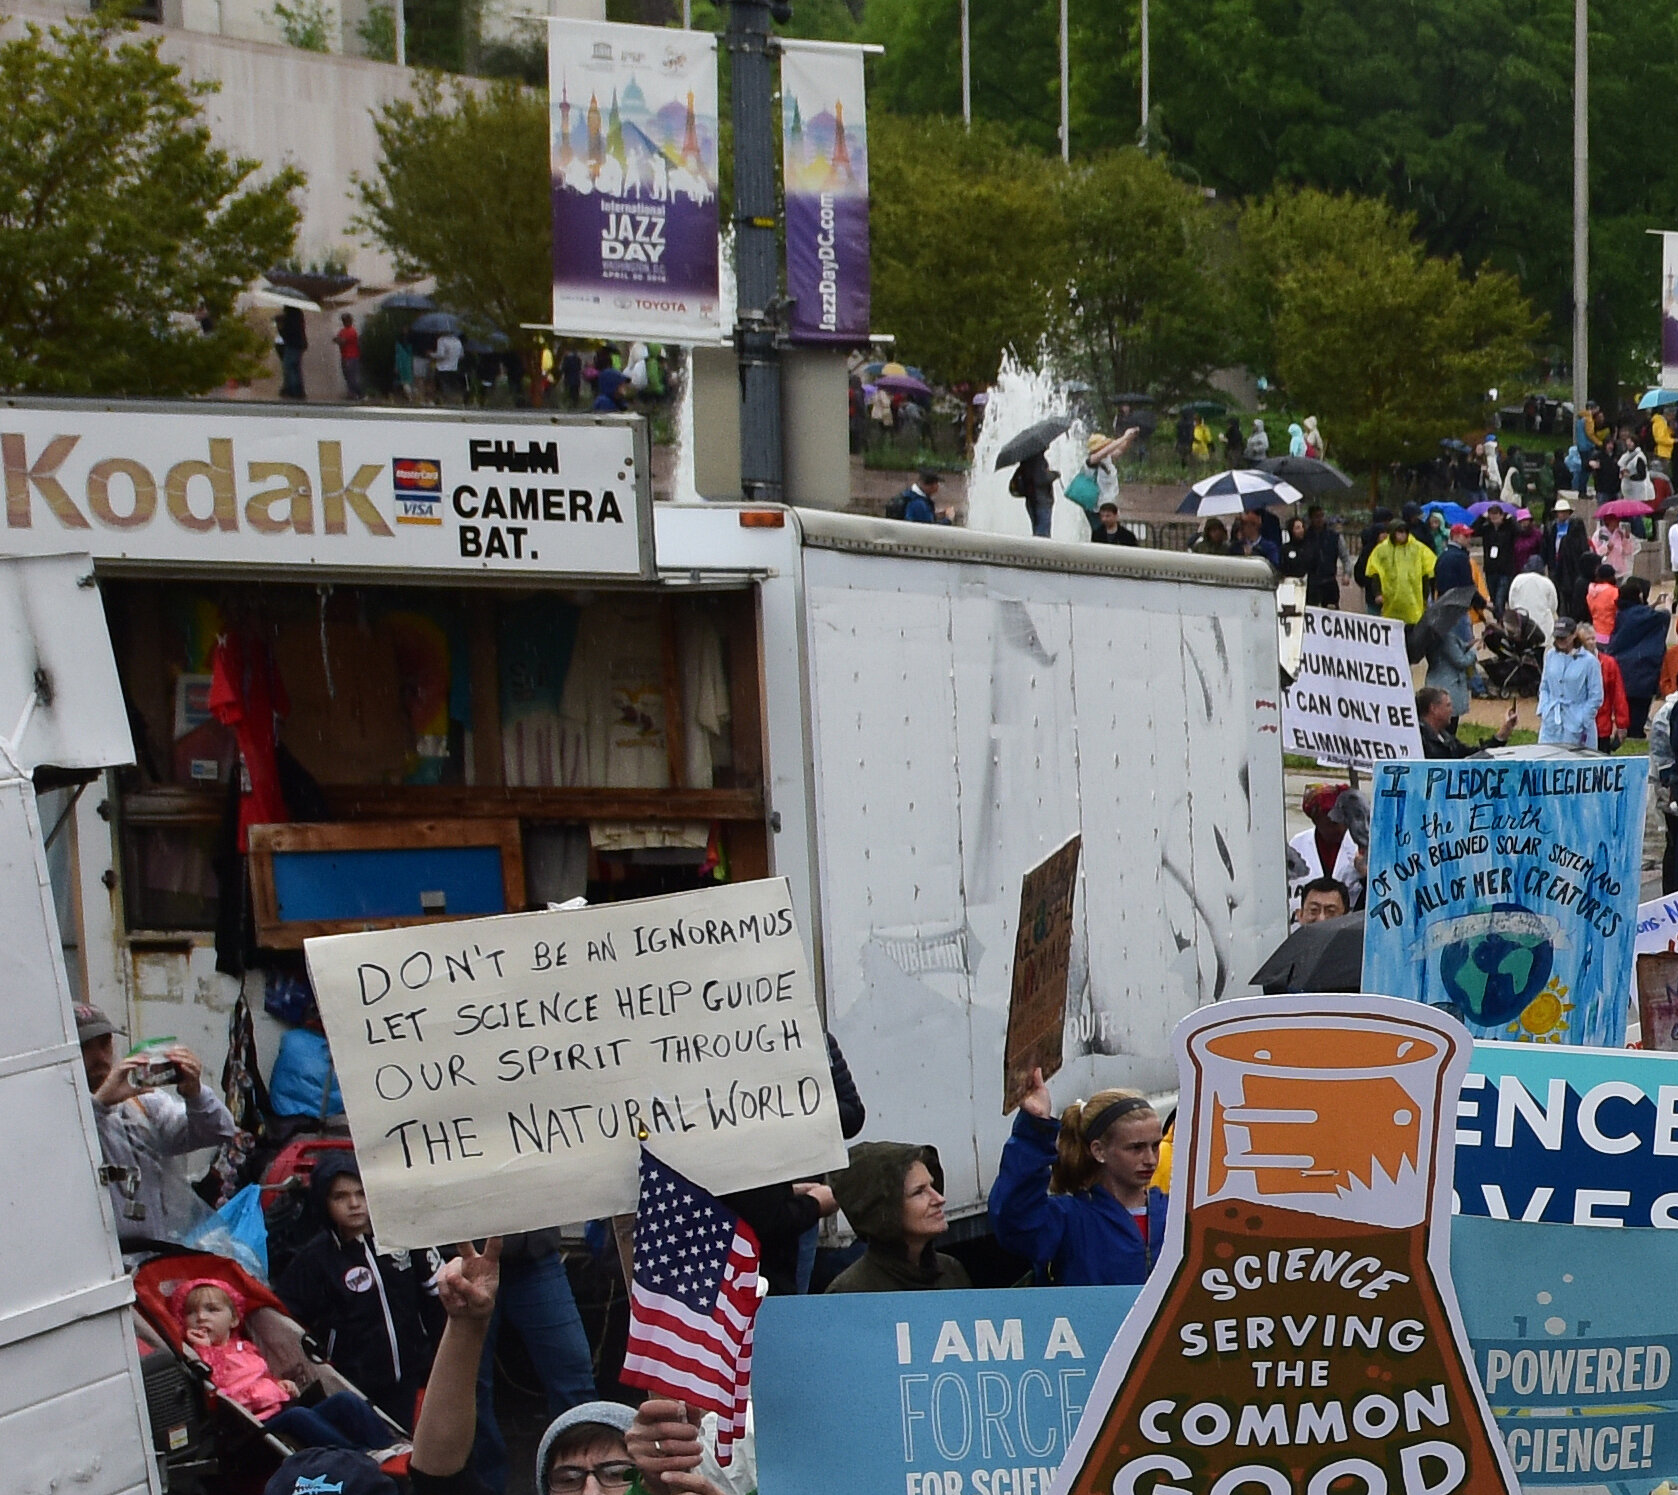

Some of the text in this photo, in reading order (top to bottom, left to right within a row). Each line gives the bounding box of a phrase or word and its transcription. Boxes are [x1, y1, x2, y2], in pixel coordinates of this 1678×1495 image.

[602, 215, 665, 242] JAZZ
[601, 241, 666, 262] DAY
[819, 193, 836, 332] JazzDayDC.com
[636, 299, 686, 313] TOYOTA
[1, 434, 395, 539] Kodak
[452, 486, 623, 523] CAMERA
[401, 503, 435, 517] VISA
[458, 526, 539, 560] BAT.
[1321, 619, 1391, 647] CANNOT
[1296, 689, 1414, 728] CAN ONLY BE
[1383, 764, 1625, 799] I PLEDGE ALLEGIENCE
[1395, 803, 1552, 845] to the Earth
[357, 907, 793, 1006] DON'T BE AN IGNORAMUS
[367, 970, 796, 1045] LET SCIENCE HELP GUIDE
[375, 1019, 802, 1100] OUR SPIRIT THROUGH
[385, 1076, 820, 1169] THE NATURAL WORLD
[1202, 1247, 1409, 1301] SCIENCE
[897, 1317, 1084, 1365] I AM A
[1181, 1314, 1426, 1356] SERVING
[1253, 1361, 1329, 1388] THE
[1487, 1346, 1671, 1394] POWERED
[1139, 1384, 1450, 1447] COMMON
